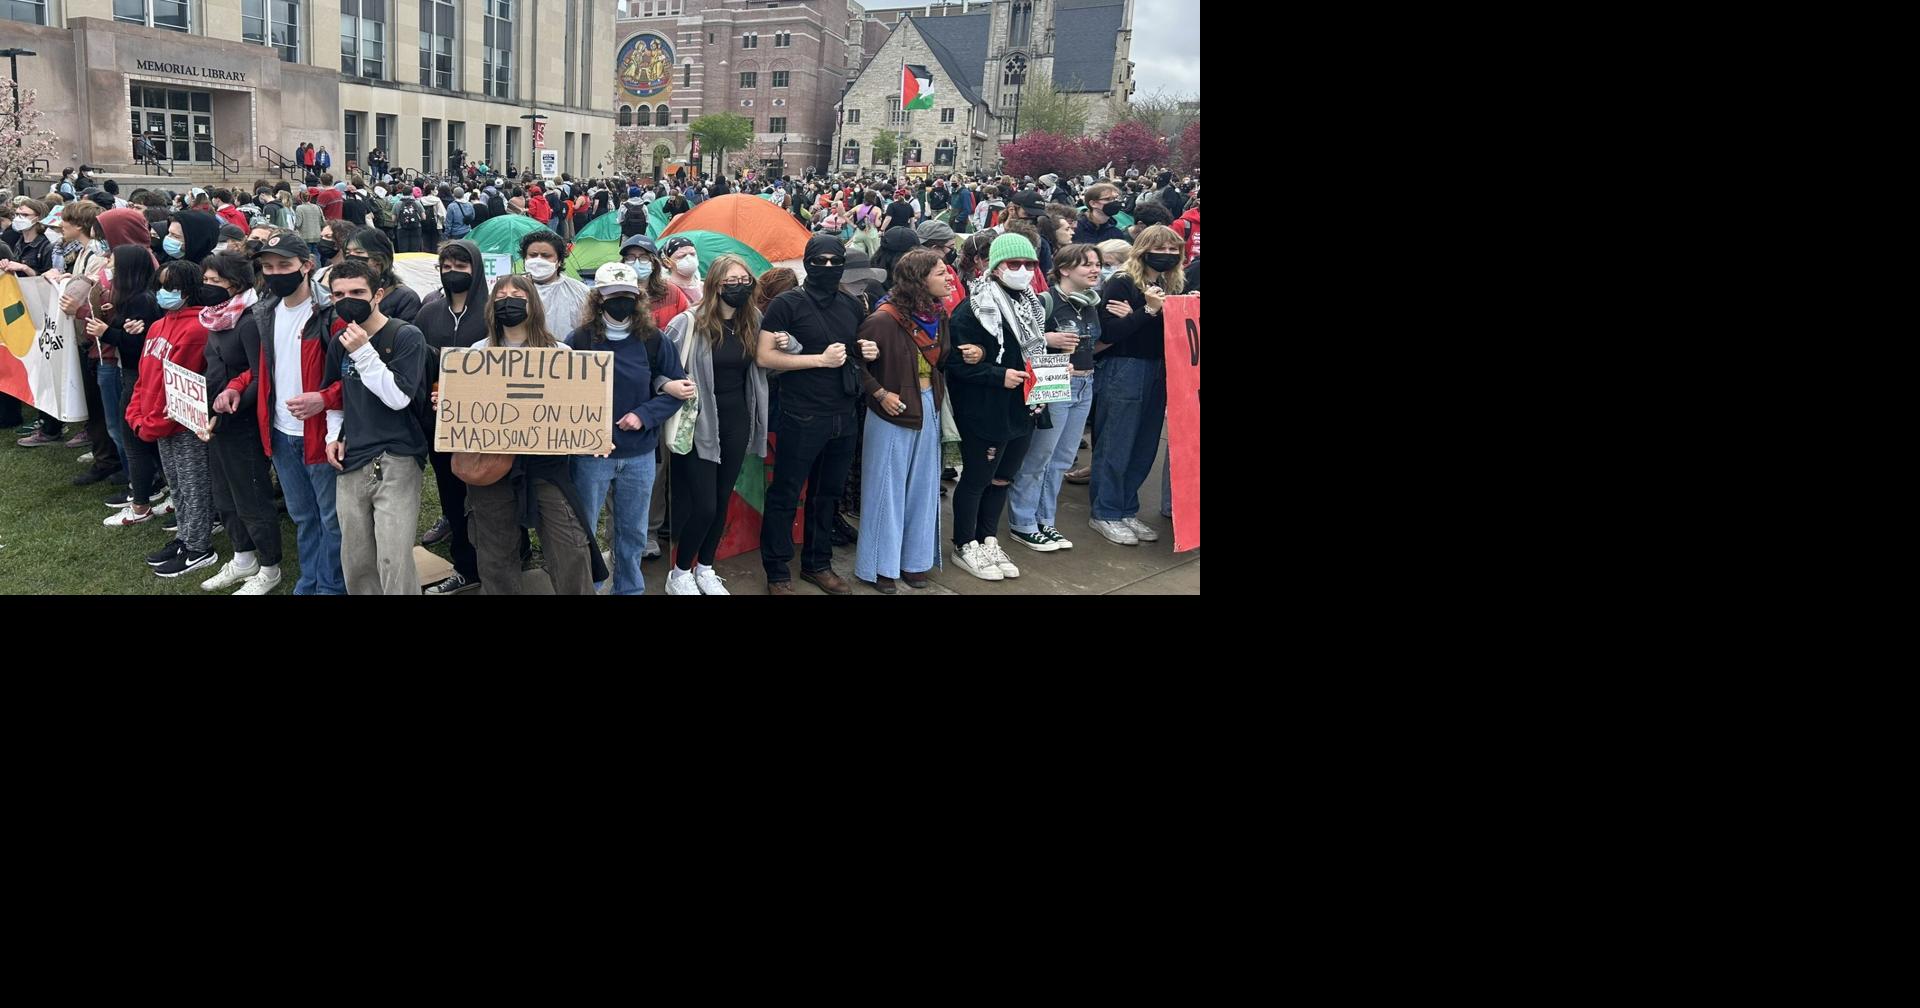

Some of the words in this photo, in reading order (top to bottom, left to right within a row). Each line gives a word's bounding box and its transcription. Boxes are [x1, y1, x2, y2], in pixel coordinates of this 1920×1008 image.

[136, 59, 199, 76] MEMORIAL
[202, 67, 246, 82] LIBRARY
[536, 122, 545, 148] 175
[440, 348, 612, 382] COMPLICITY
[164, 368, 206, 403] DIVEST
[440, 399, 520, 425] BLOOD
[533, 404, 561, 424] ON
[570, 404, 602, 424] UW
[547, 428, 605, 450] HANDS
